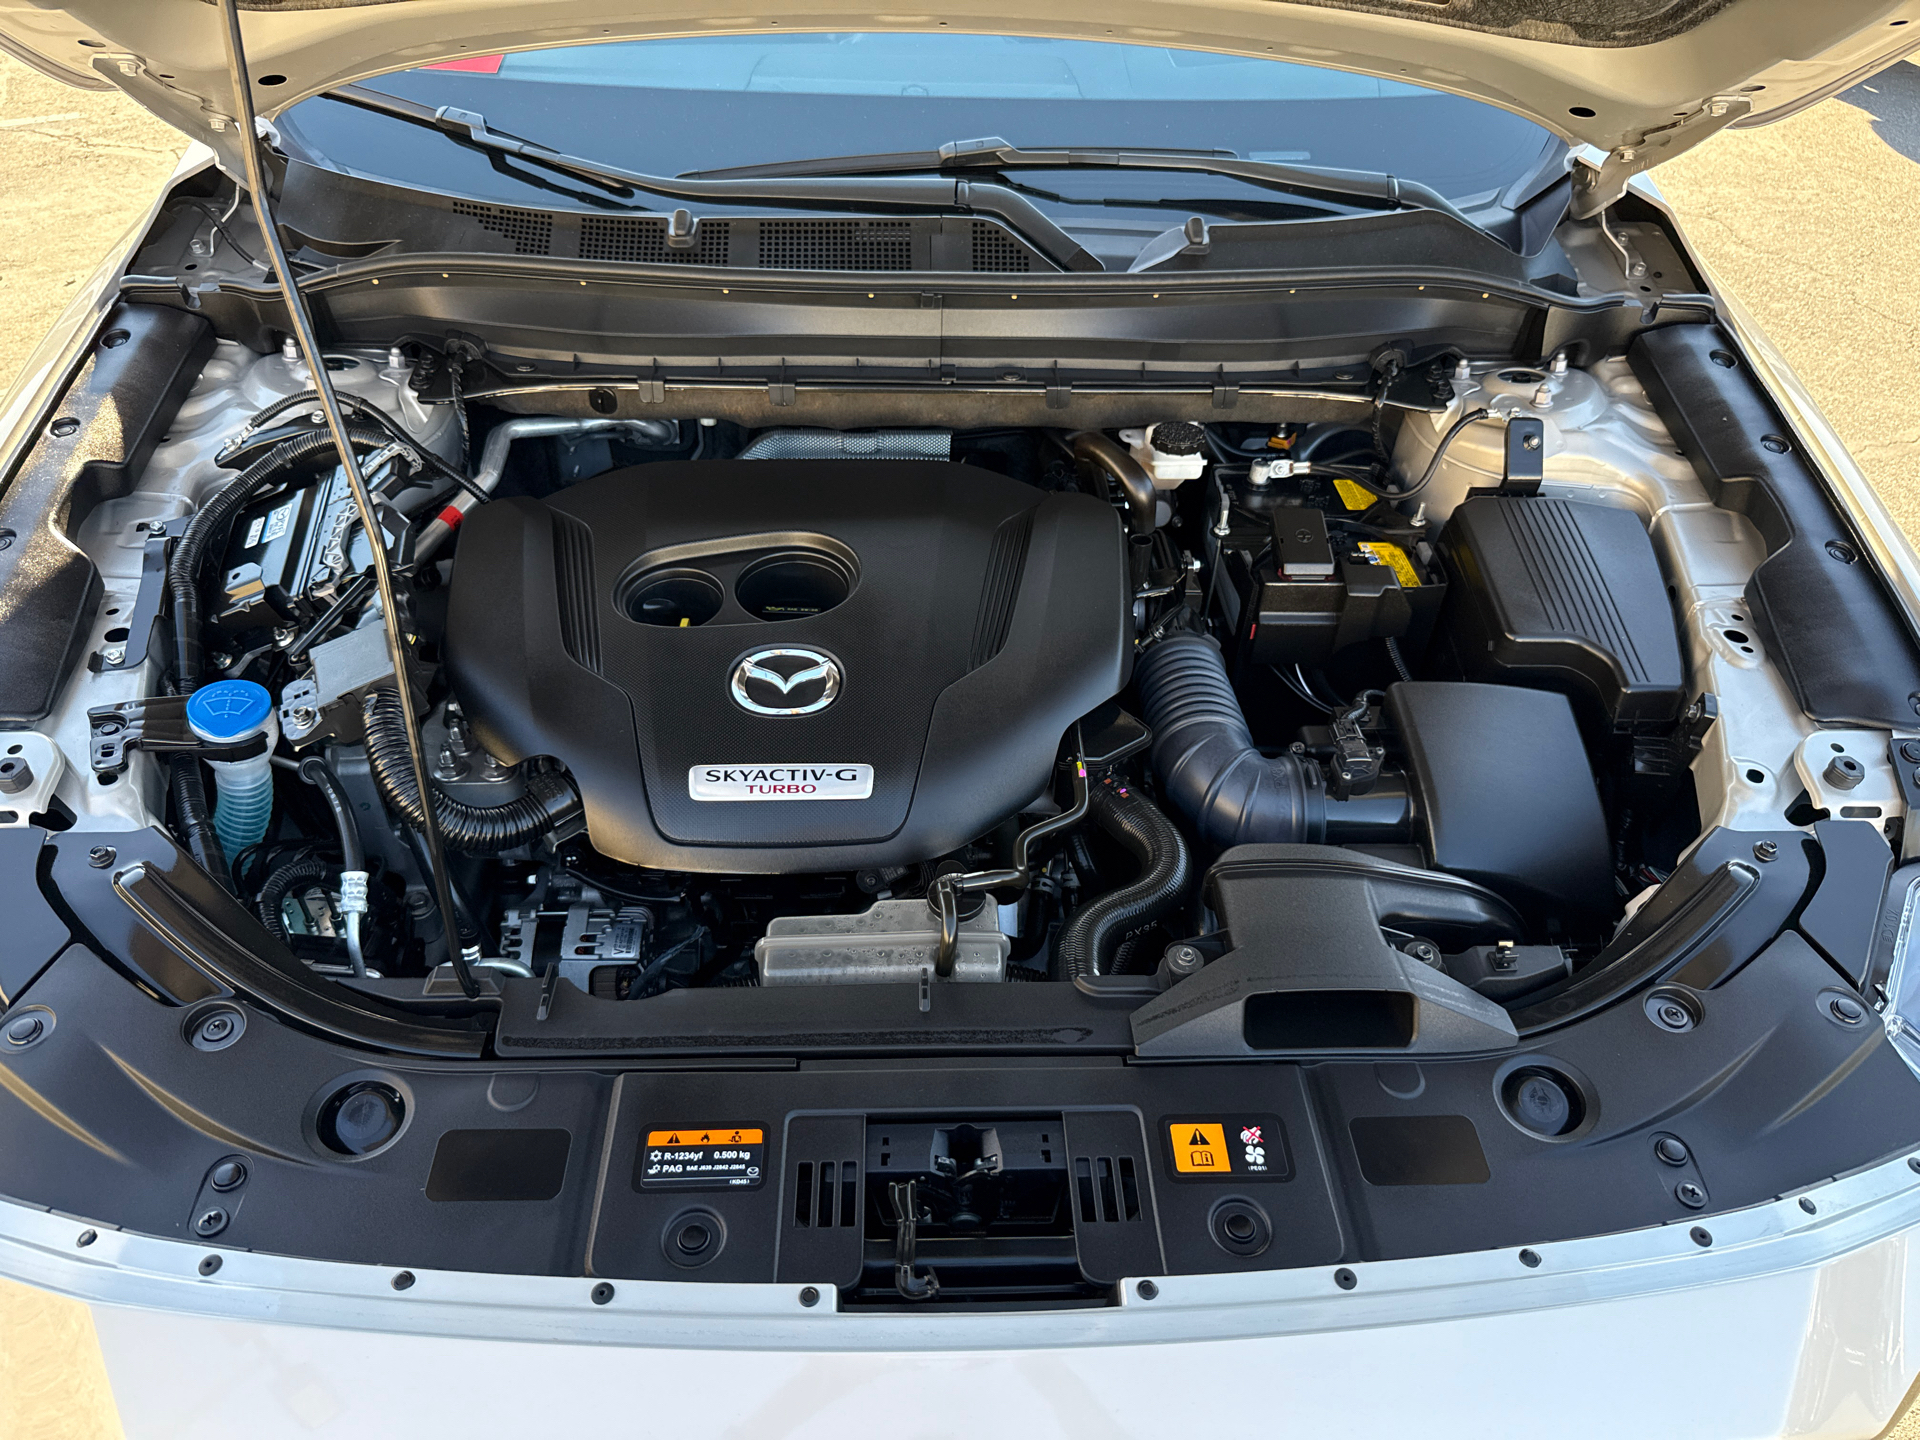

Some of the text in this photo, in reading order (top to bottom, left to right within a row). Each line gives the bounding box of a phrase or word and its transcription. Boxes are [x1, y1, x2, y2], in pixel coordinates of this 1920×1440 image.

[705, 769, 858, 782] SKYACTIV-G
[745, 784, 817, 794] TURBO
[663, 1150, 751, 1161] R-1234yf 0.500 kg
[662, 1164, 683, 1173] PAG
